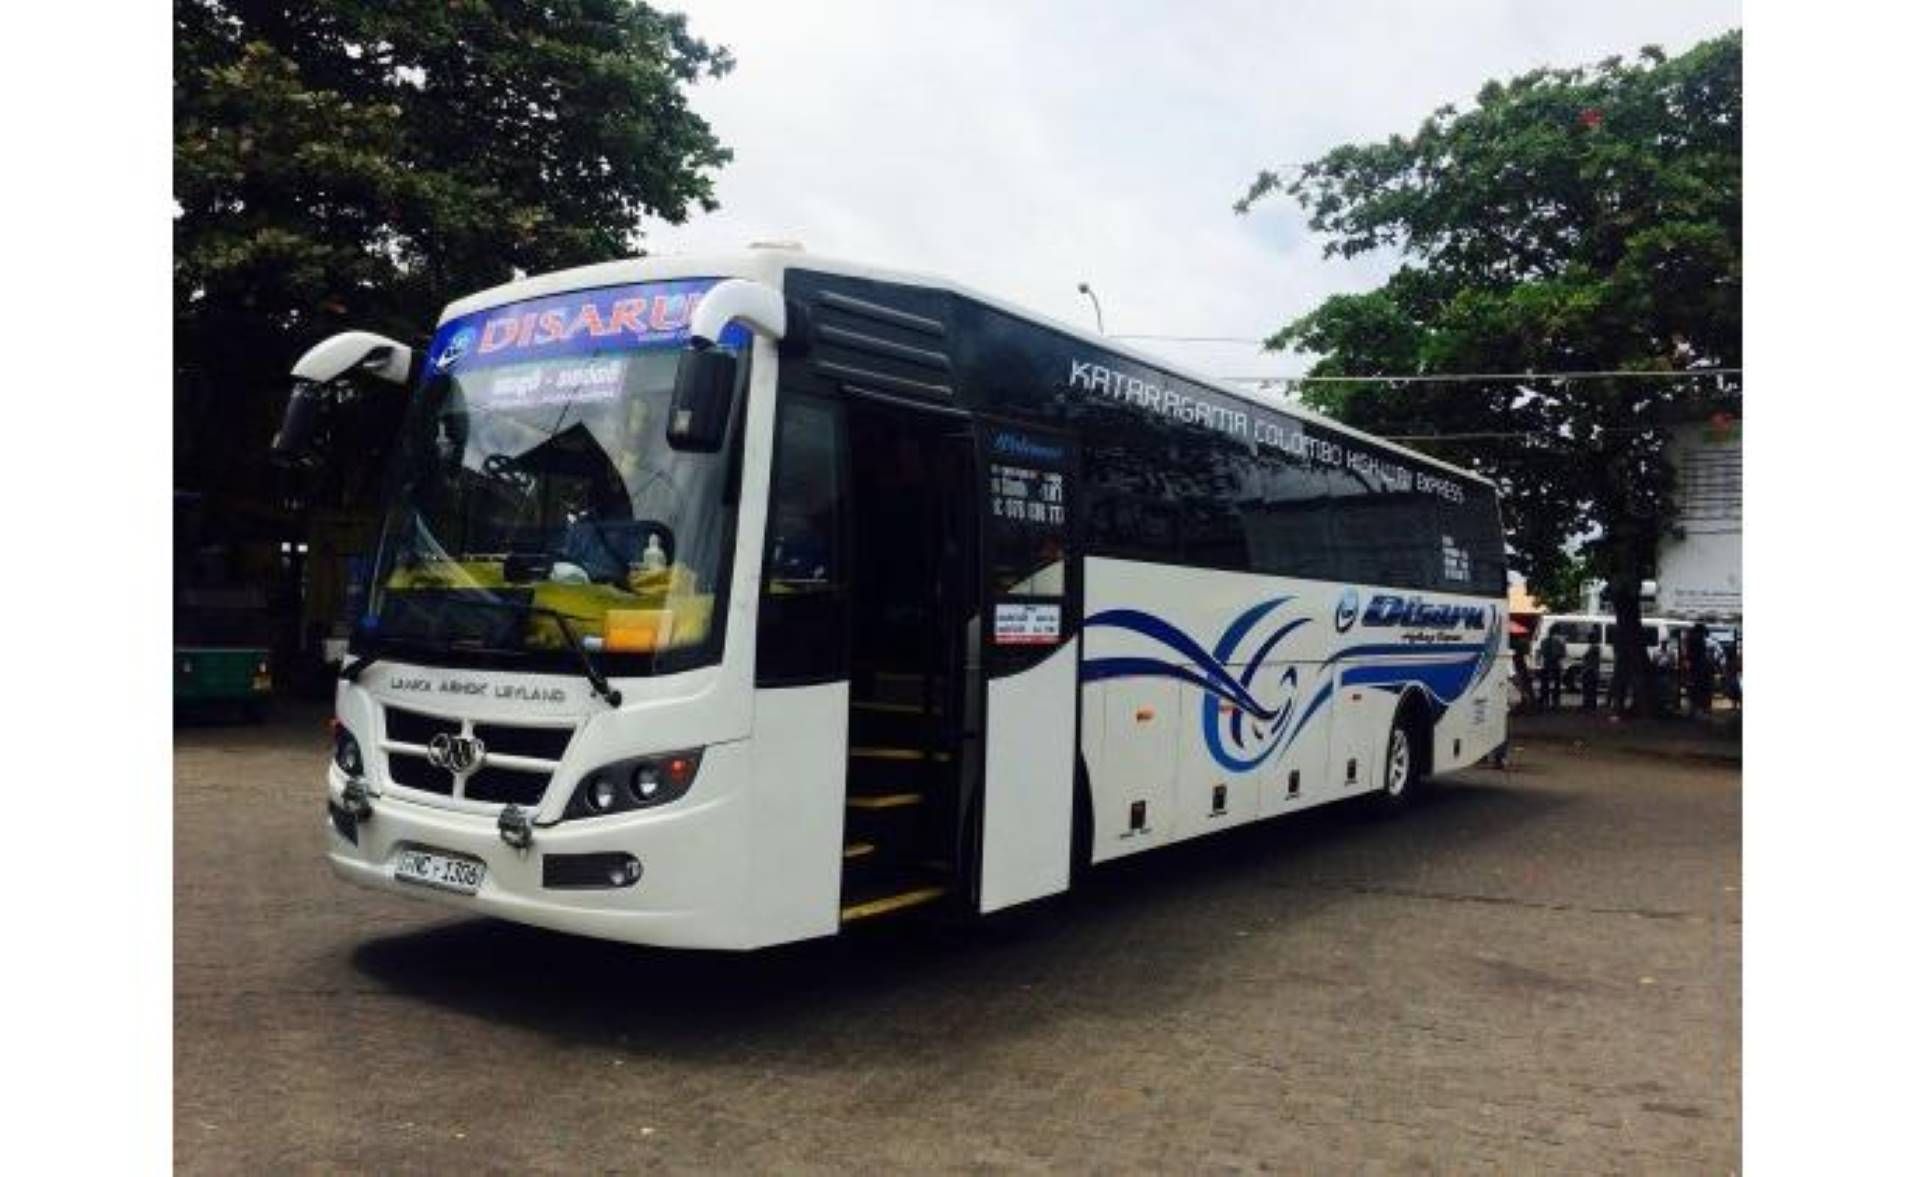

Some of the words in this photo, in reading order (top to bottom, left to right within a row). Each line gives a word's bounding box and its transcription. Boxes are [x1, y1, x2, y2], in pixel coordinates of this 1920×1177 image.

[1069, 359, 1248, 434] KATARAGAMA
[1253, 419, 1343, 468] COLOMBO
[494, 684, 567, 703] LEYLAND
